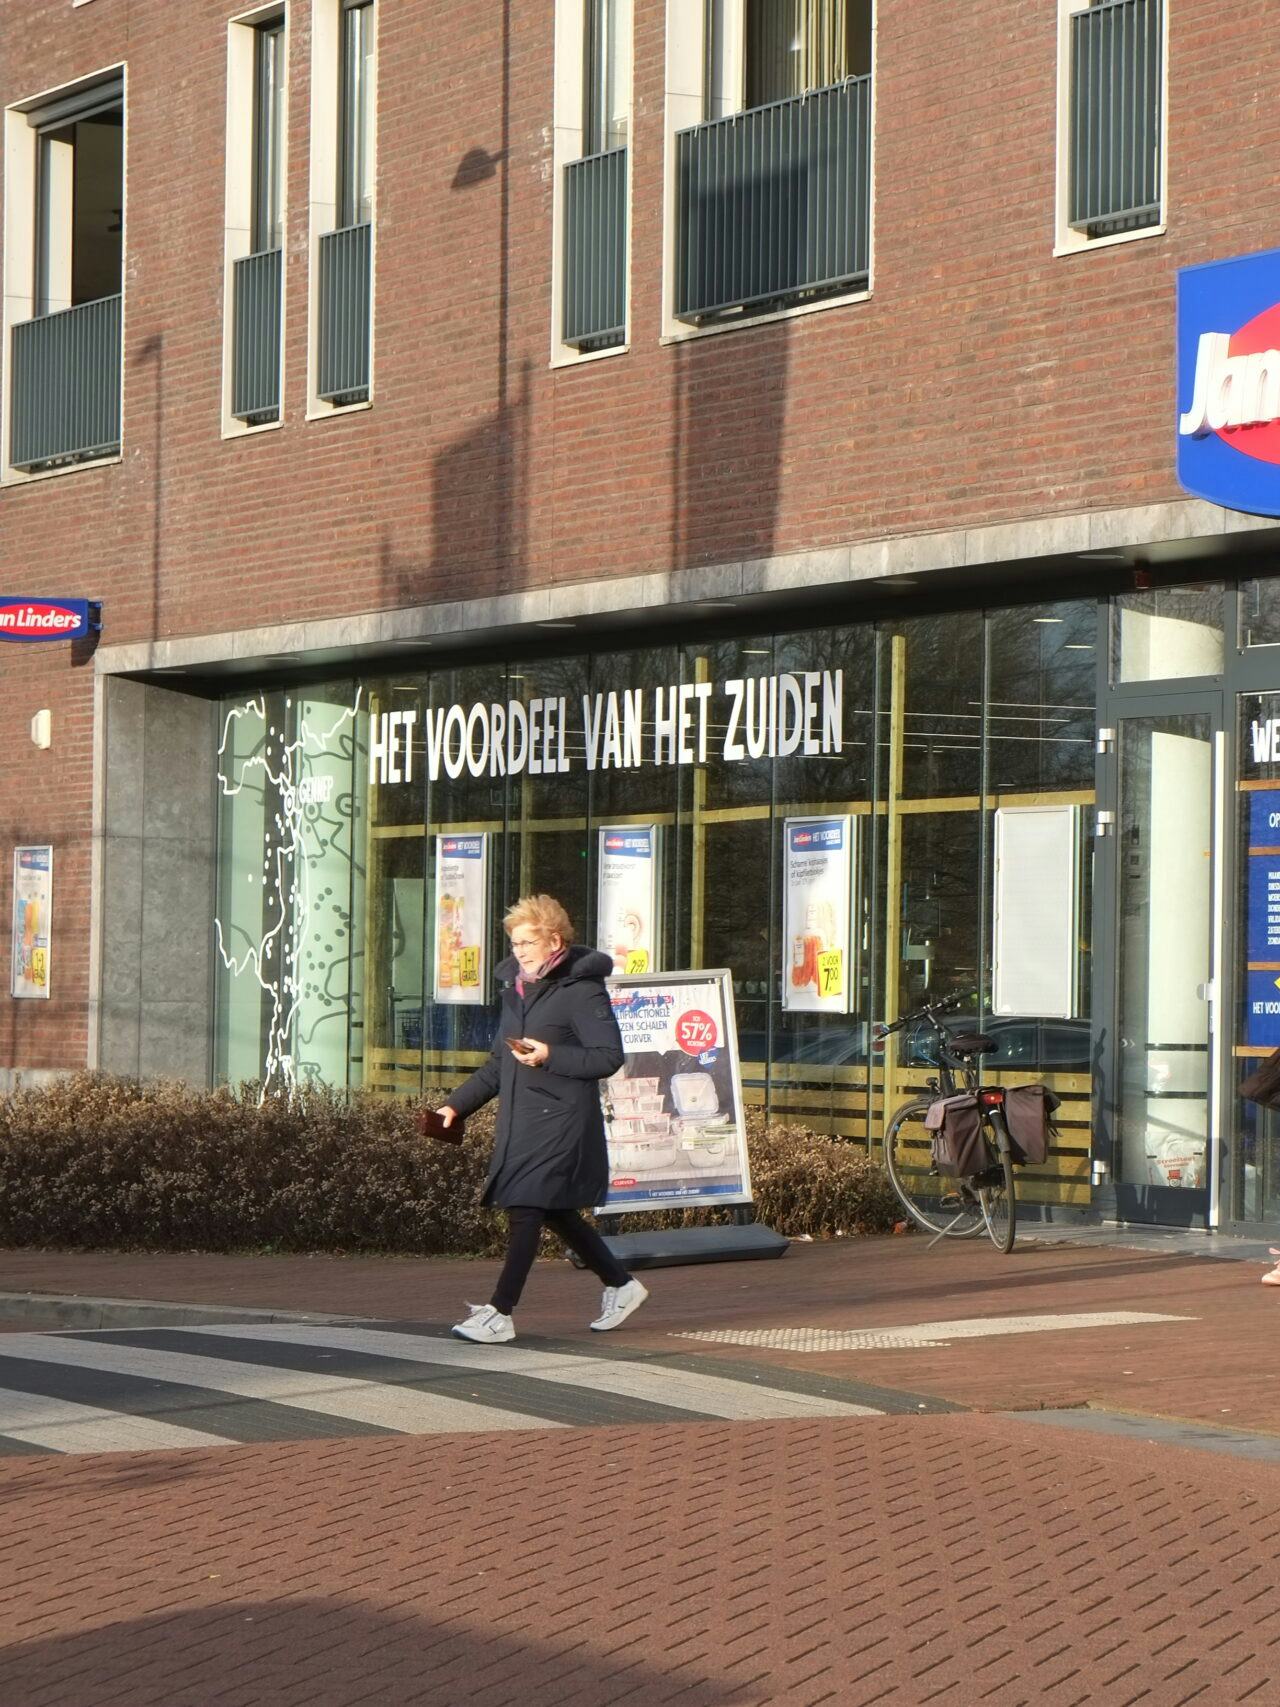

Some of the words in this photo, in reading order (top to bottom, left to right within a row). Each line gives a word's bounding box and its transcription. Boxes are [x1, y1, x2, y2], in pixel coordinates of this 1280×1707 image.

[17, 607, 81, 628] Linders
[369, 710, 417, 785] HET
[426, 697, 570, 781] VOORDEEL
[583, 688, 643, 771] VAN
[655, 682, 712, 766] HET
[723, 669, 843, 761] ZUIDEN
[1252, 1001, 1264, 1014] HET
[636, 1021, 667, 1031] SCHALEN
[681, 1022, 713, 1041] 57%
[624, 1034, 652, 1044] CURVER
